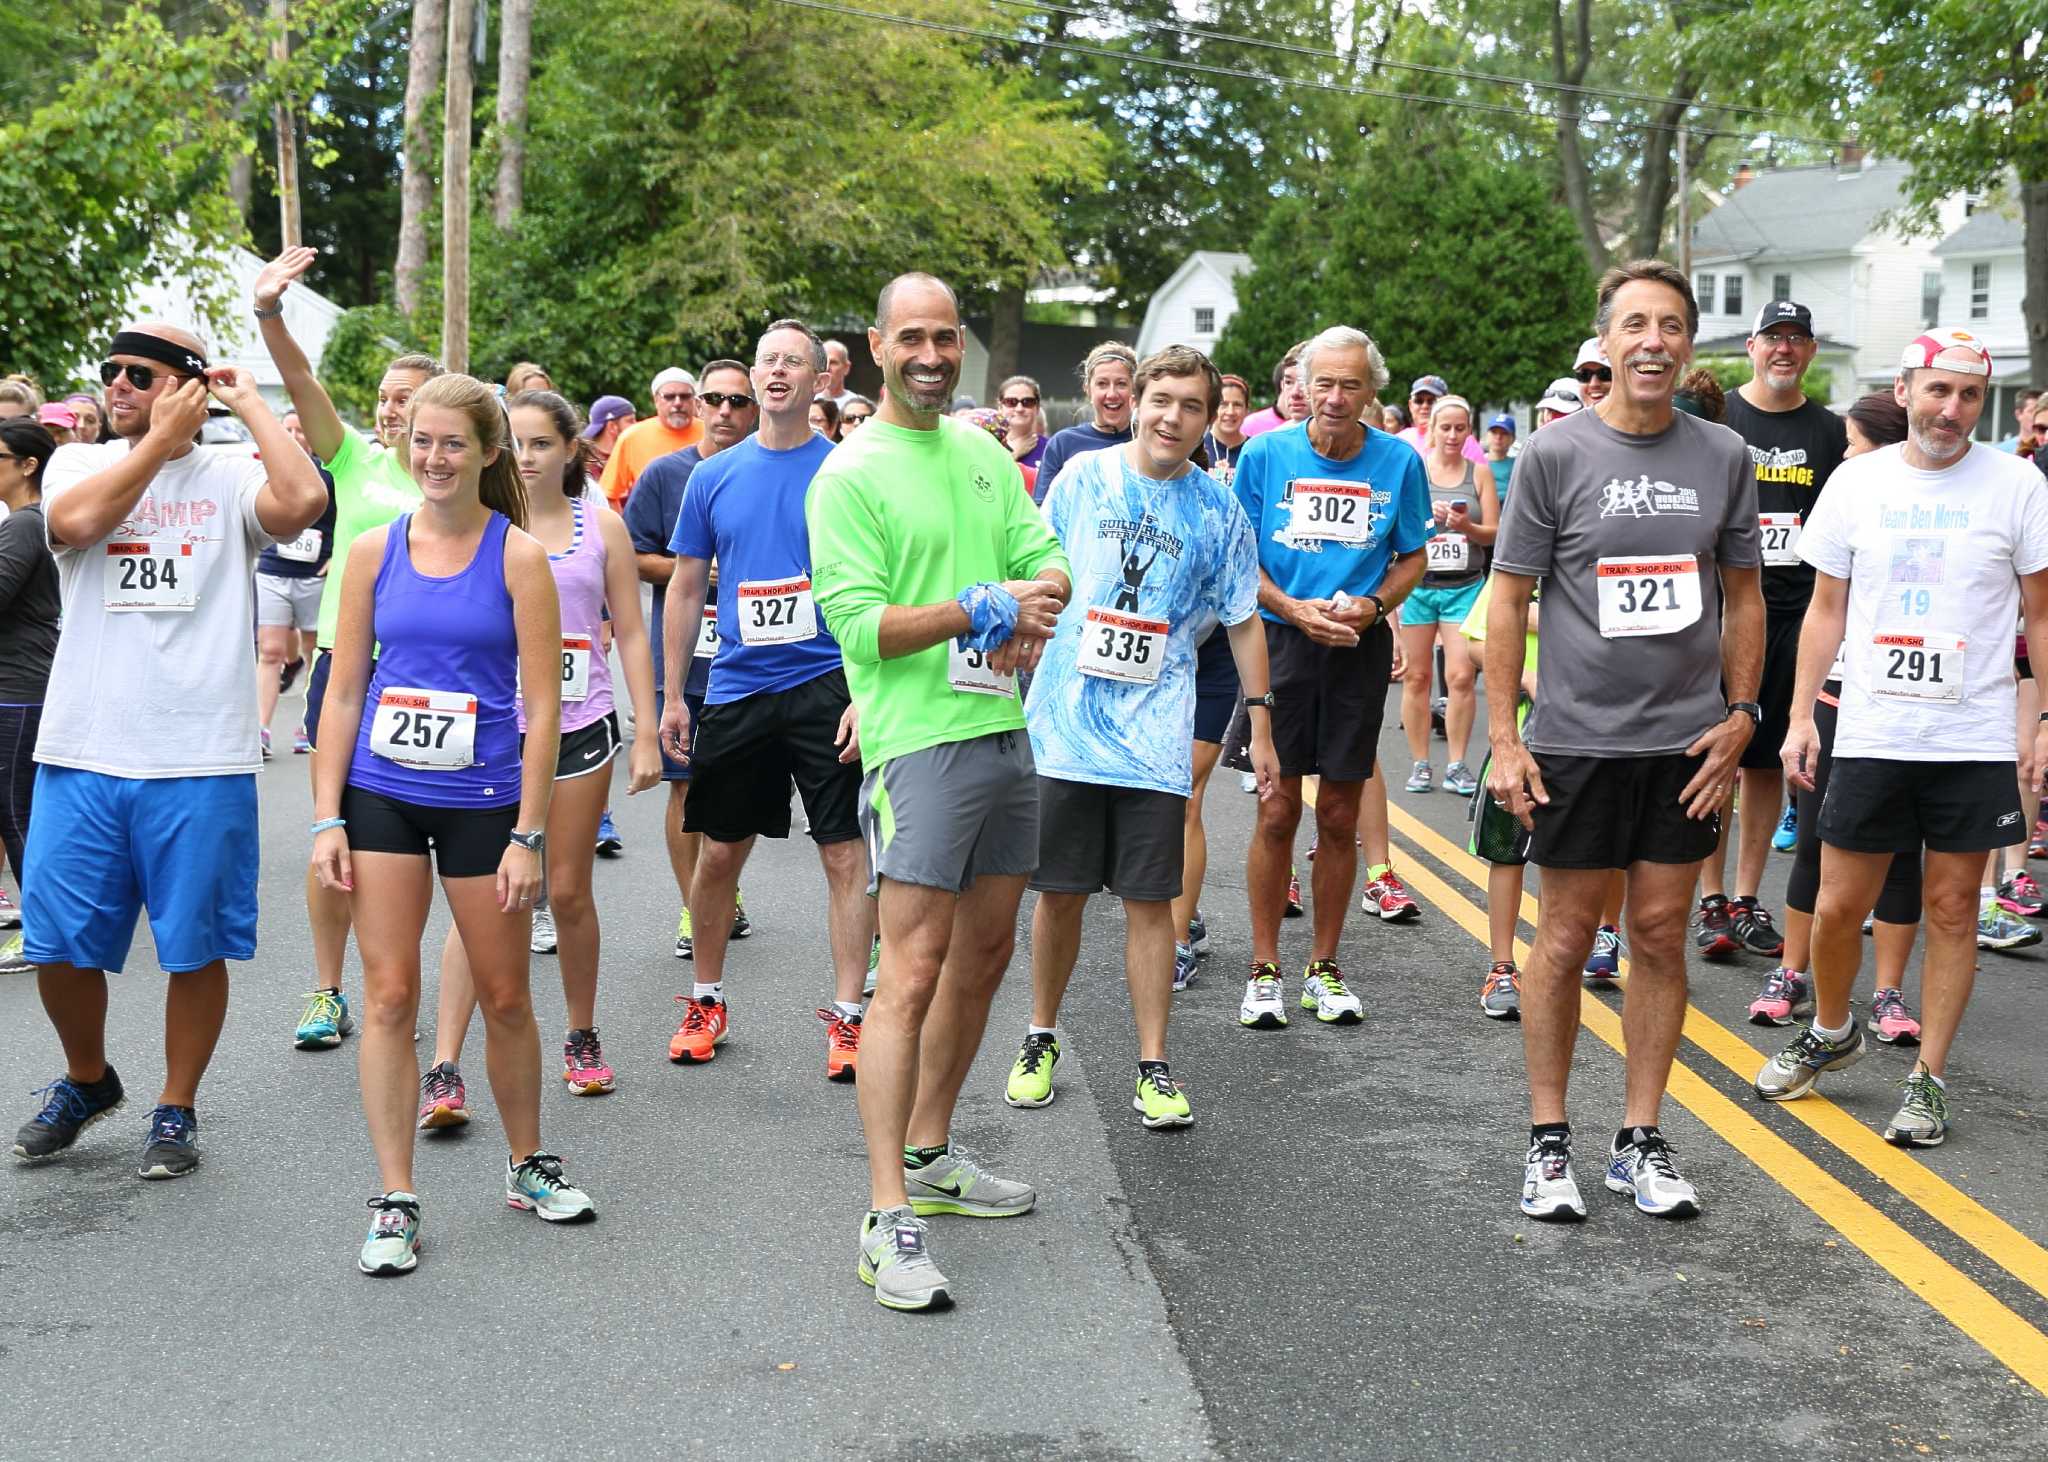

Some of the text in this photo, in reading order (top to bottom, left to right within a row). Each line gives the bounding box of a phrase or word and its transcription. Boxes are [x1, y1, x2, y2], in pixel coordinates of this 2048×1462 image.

[1308, 496, 1356, 524] 302
[1910, 504, 1932, 528] Ben
[1934, 504, 1969, 528] Morris
[1096, 530, 1181, 561] INTERNATIONAL
[1099, 519, 1184, 551] GUILDERLAND
[1431, 544, 1460, 560] 269
[119, 558, 178, 590] 284
[1605, 564, 1685, 575] TRAIN. SHOP. RUN.
[1617, 578, 1681, 613] 321
[1900, 589, 1930, 616] 19
[751, 596, 798, 627] 327
[1096, 627, 1153, 664] 335
[1887, 649, 1943, 683] 291
[389, 711, 455, 749] 257
